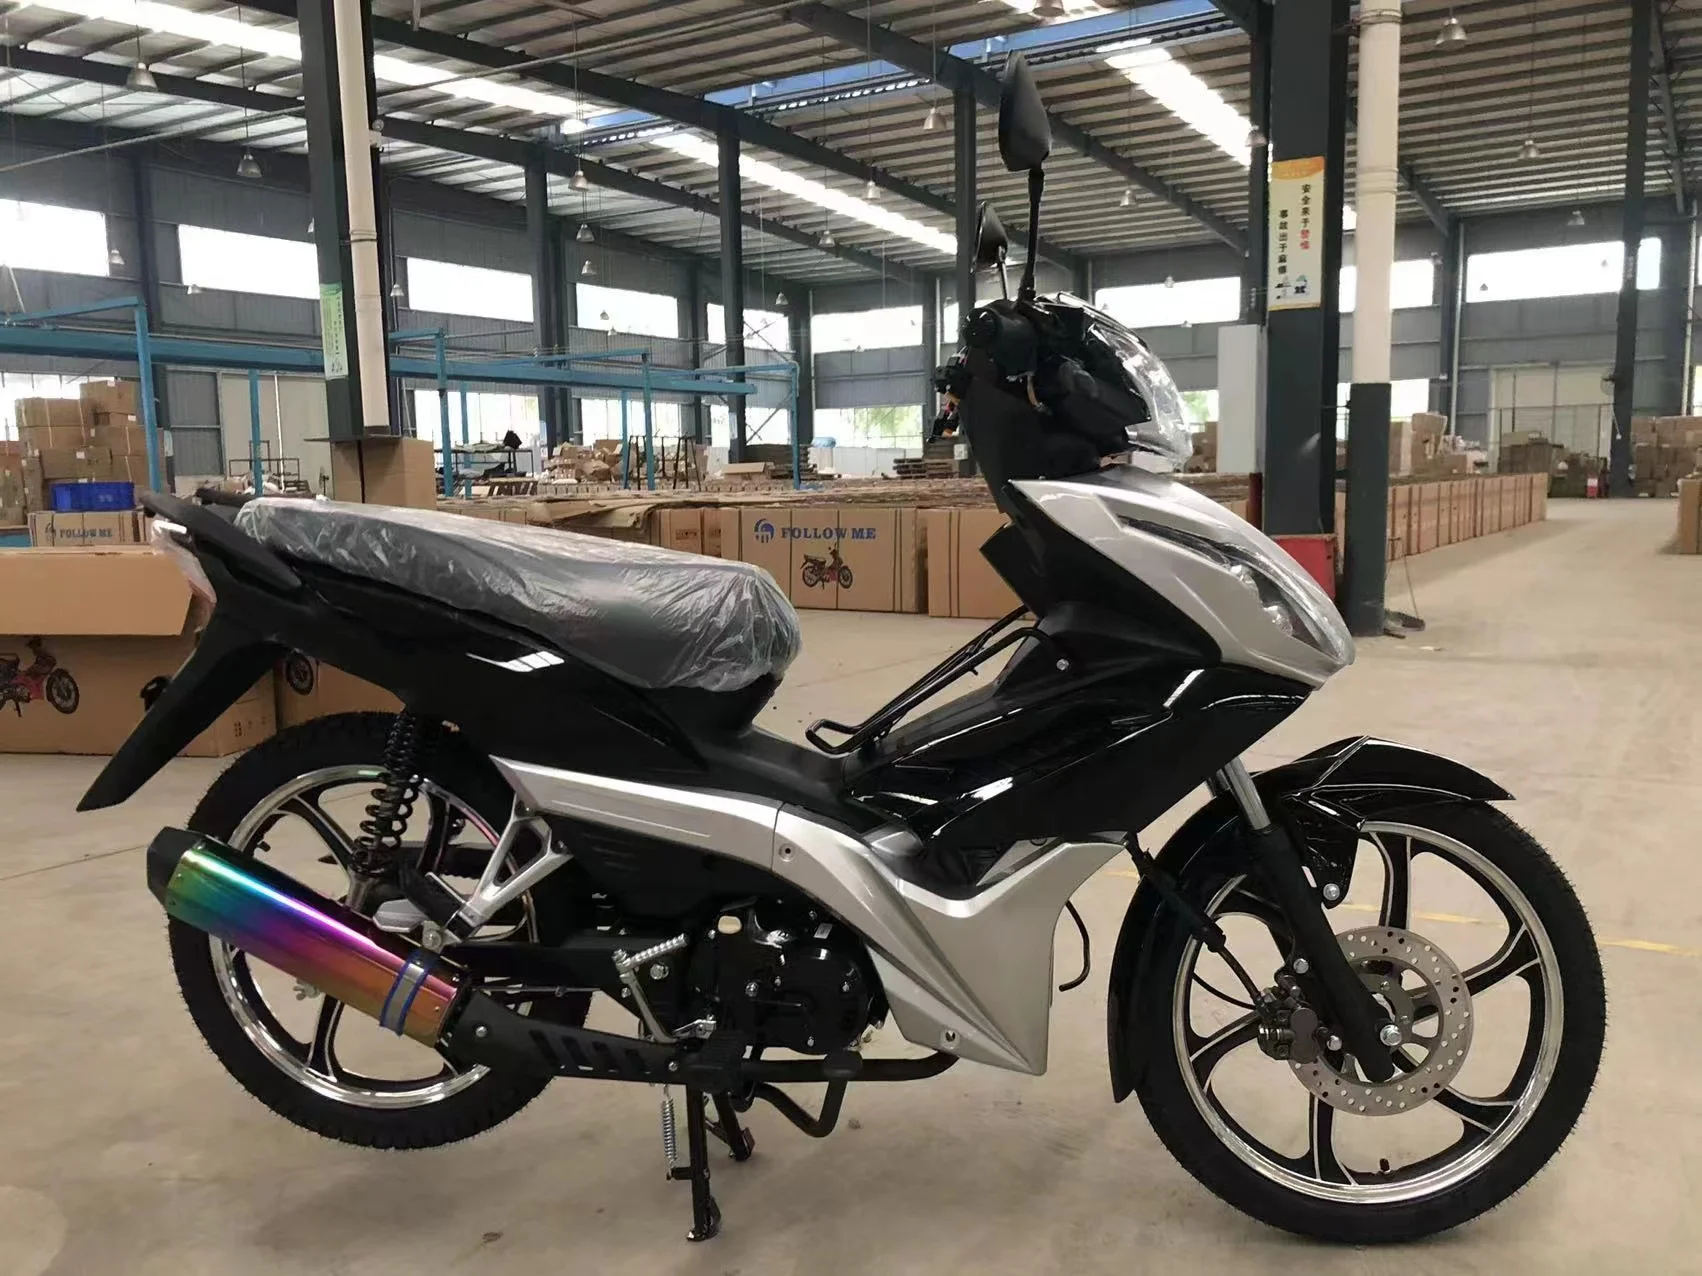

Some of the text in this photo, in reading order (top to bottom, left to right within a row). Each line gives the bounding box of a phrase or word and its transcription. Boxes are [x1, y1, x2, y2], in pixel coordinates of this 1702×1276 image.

[59, 528, 113, 538] FOLLOW ME
[781, 527, 877, 540] FOLLOW ME
